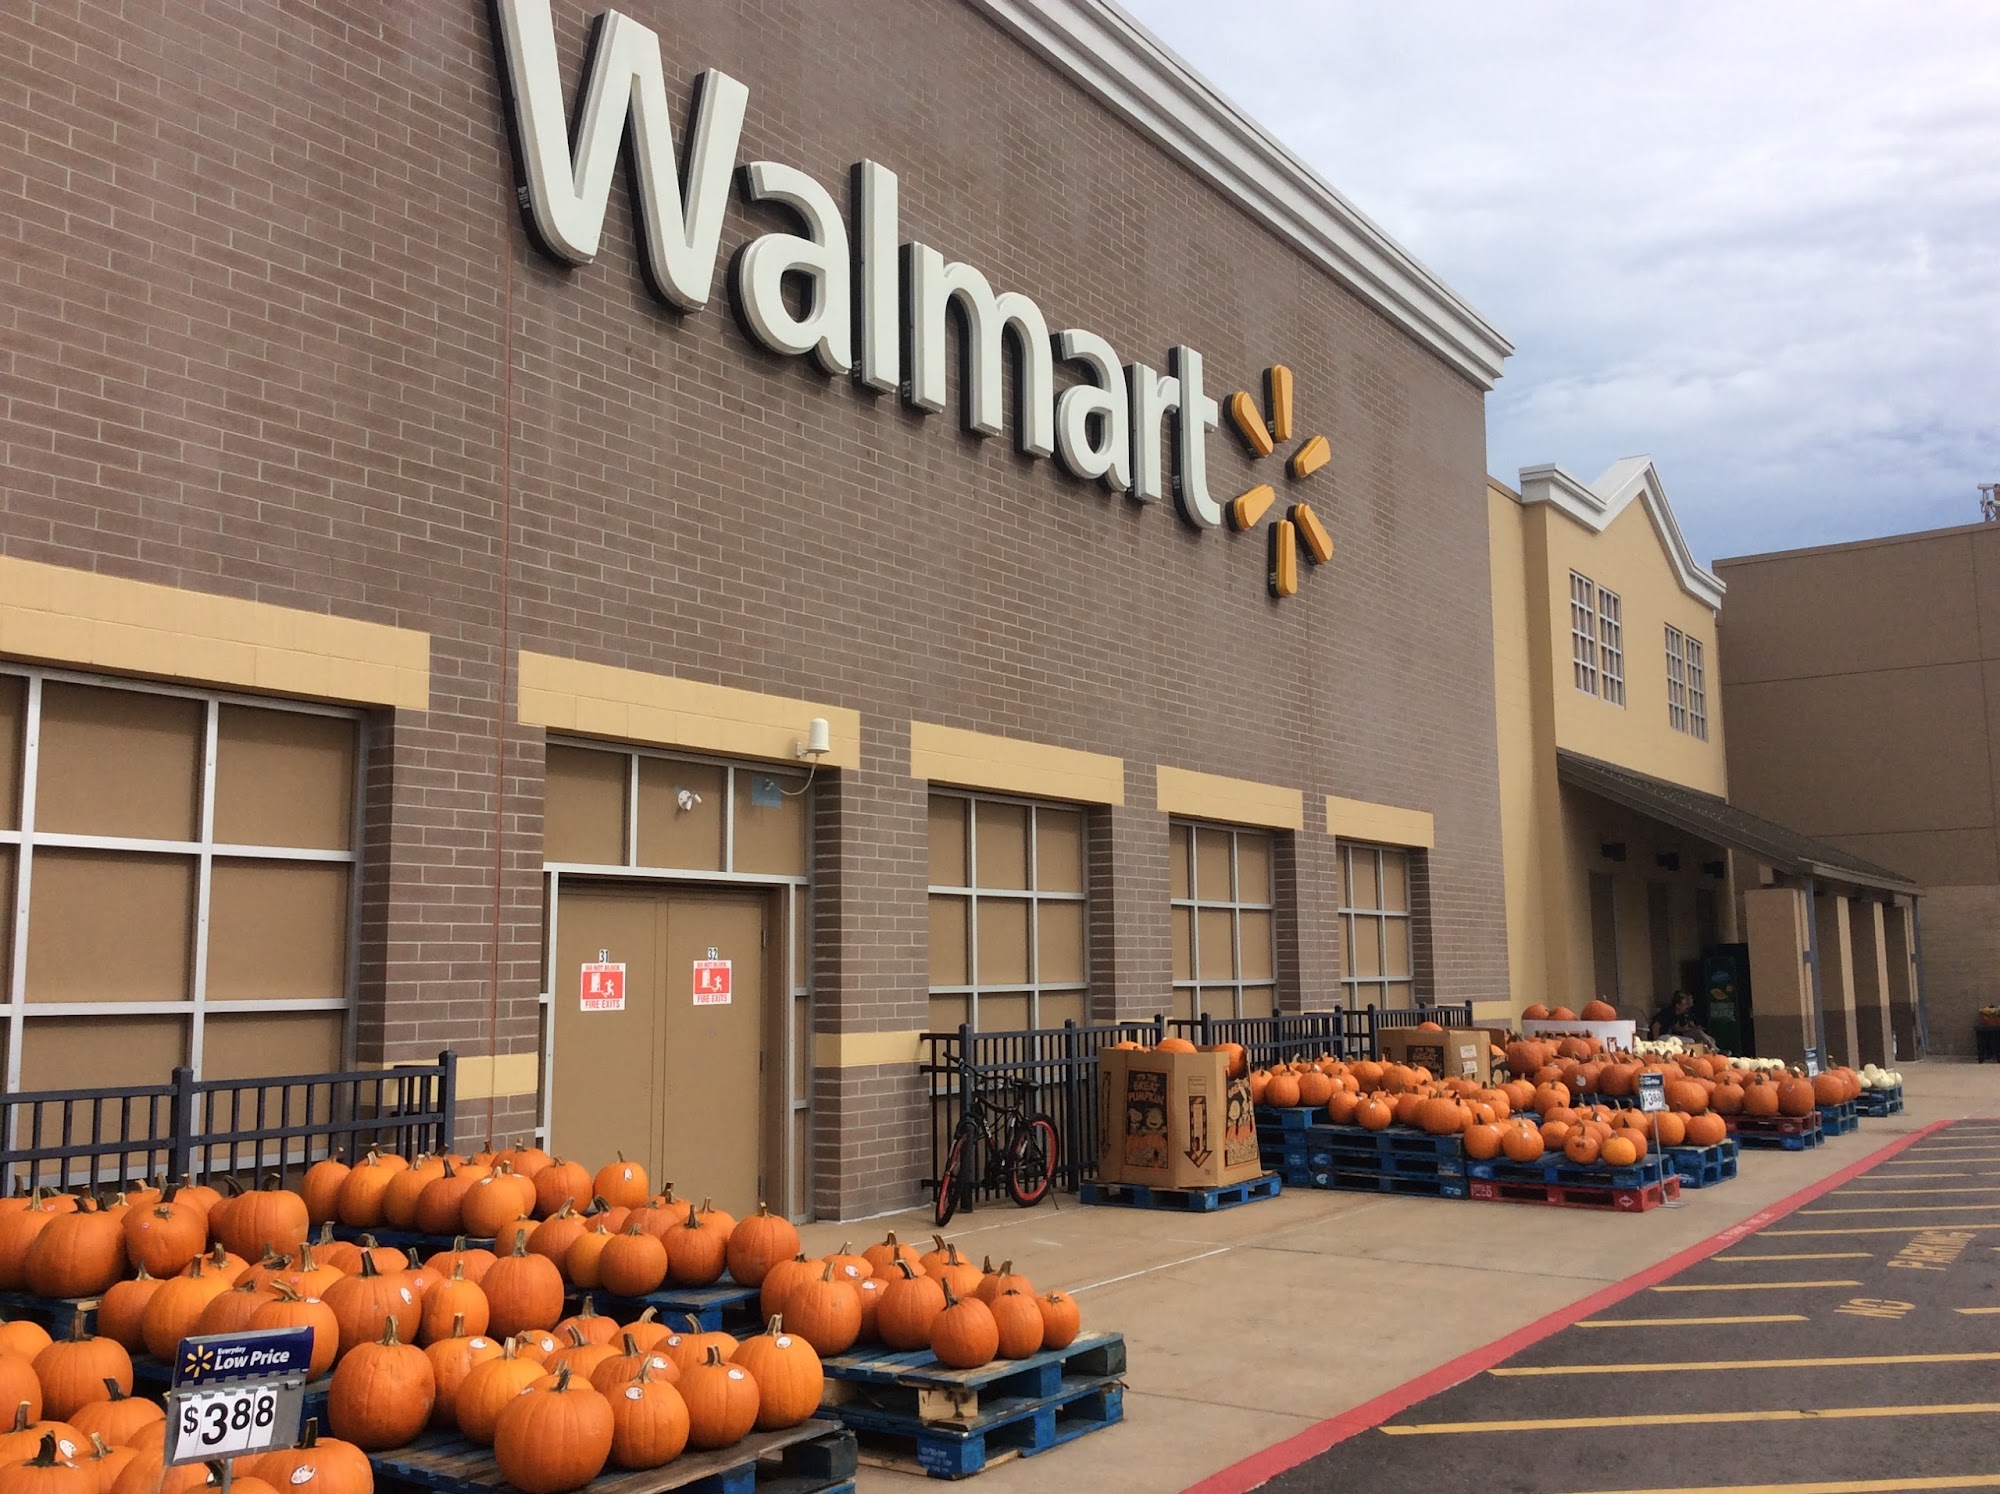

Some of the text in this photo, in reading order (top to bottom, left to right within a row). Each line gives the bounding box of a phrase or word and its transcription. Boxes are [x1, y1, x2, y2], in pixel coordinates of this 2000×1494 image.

[491, 0, 1222, 528] Walmart
[599, 949, 609, 963] 31
[708, 948, 718, 960] 32
[585, 1000, 621, 1009] FIRE EXITS
[697, 994, 728, 1003] FIRE EXITS
[217, 1346, 247, 1355] Everyday
[214, 1348, 290, 1371] Low Price
